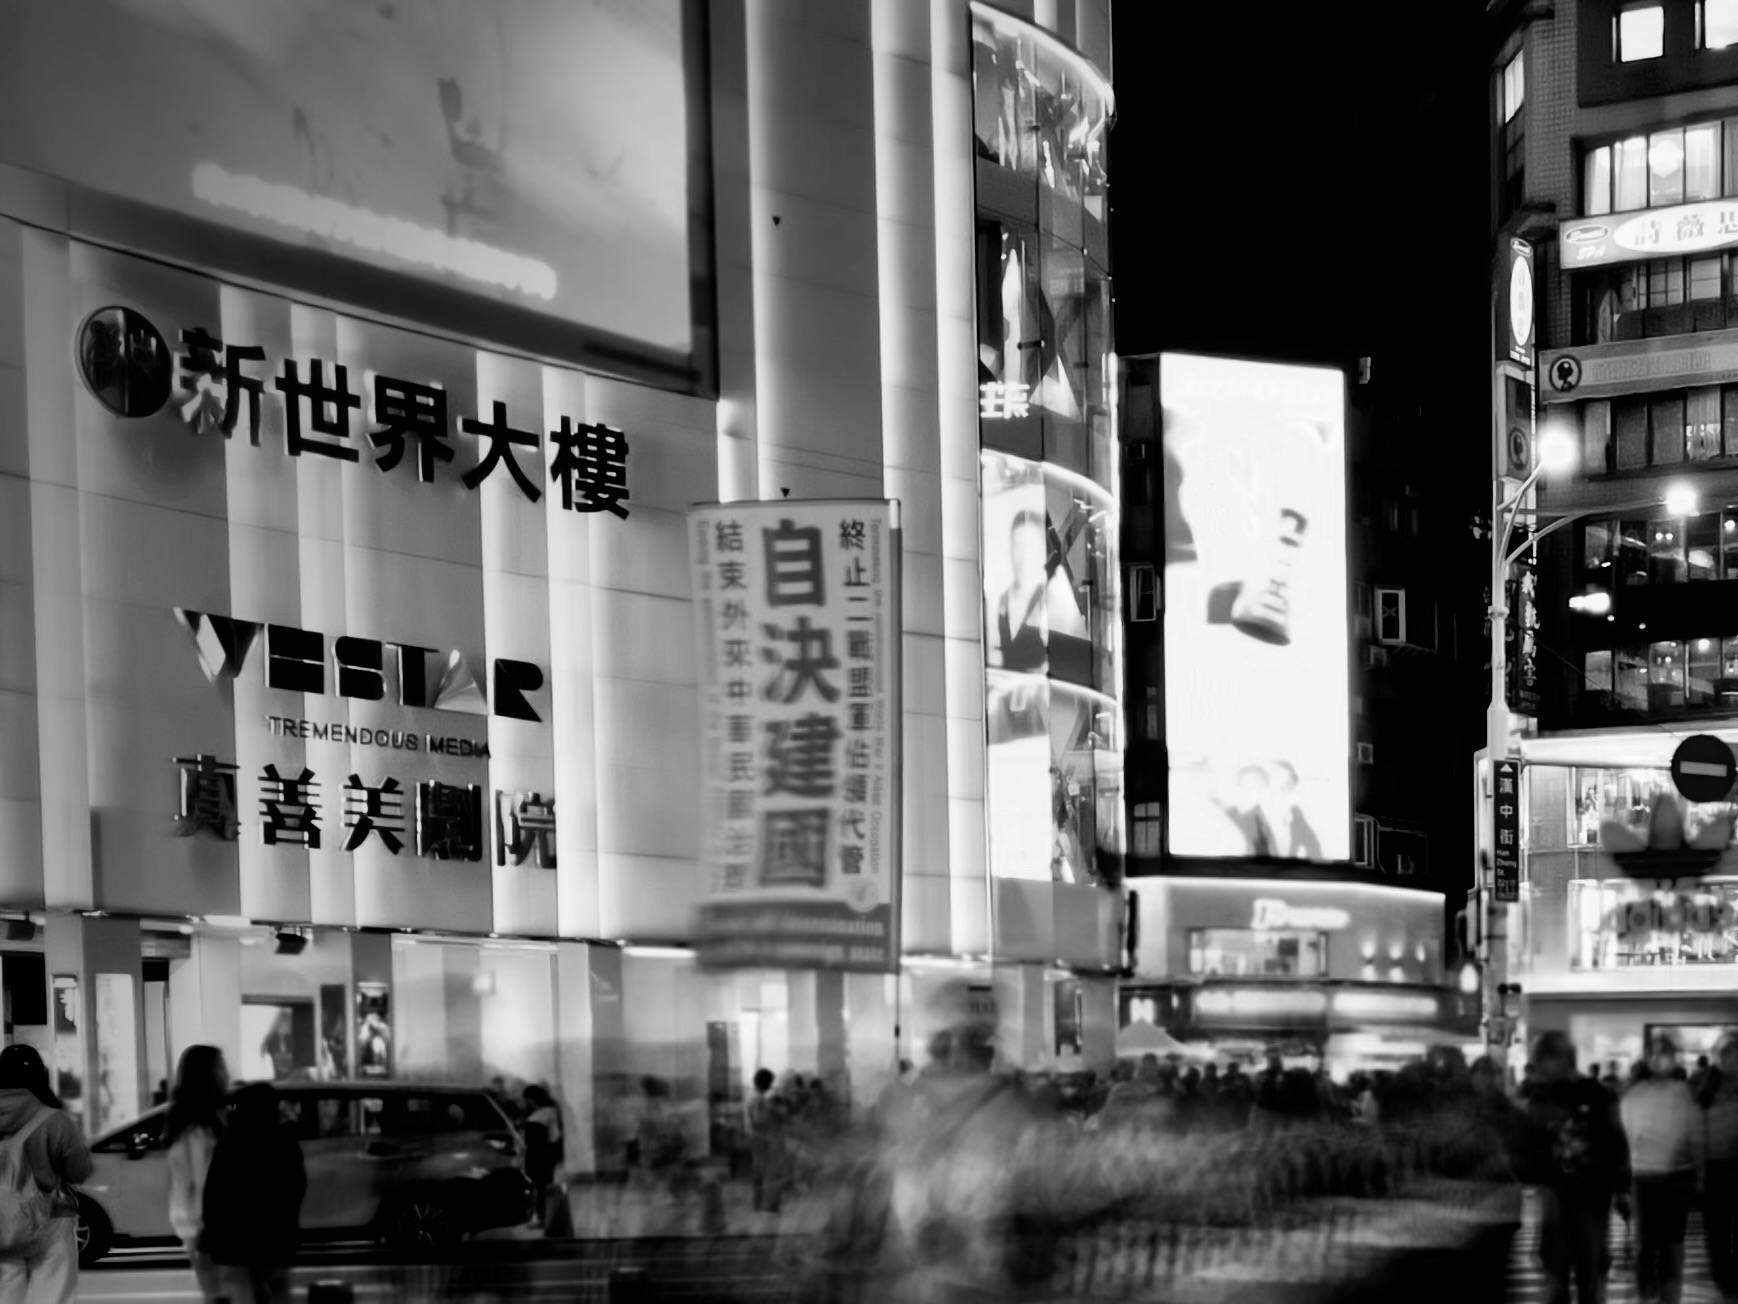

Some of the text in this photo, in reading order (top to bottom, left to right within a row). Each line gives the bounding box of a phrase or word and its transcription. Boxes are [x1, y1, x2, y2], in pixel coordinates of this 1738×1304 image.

[174, 327, 630, 521] 新世界大樓
[267, 714, 492, 760] TREMENDOUS MEDIA
[758, 519, 842, 888] 自決建國
